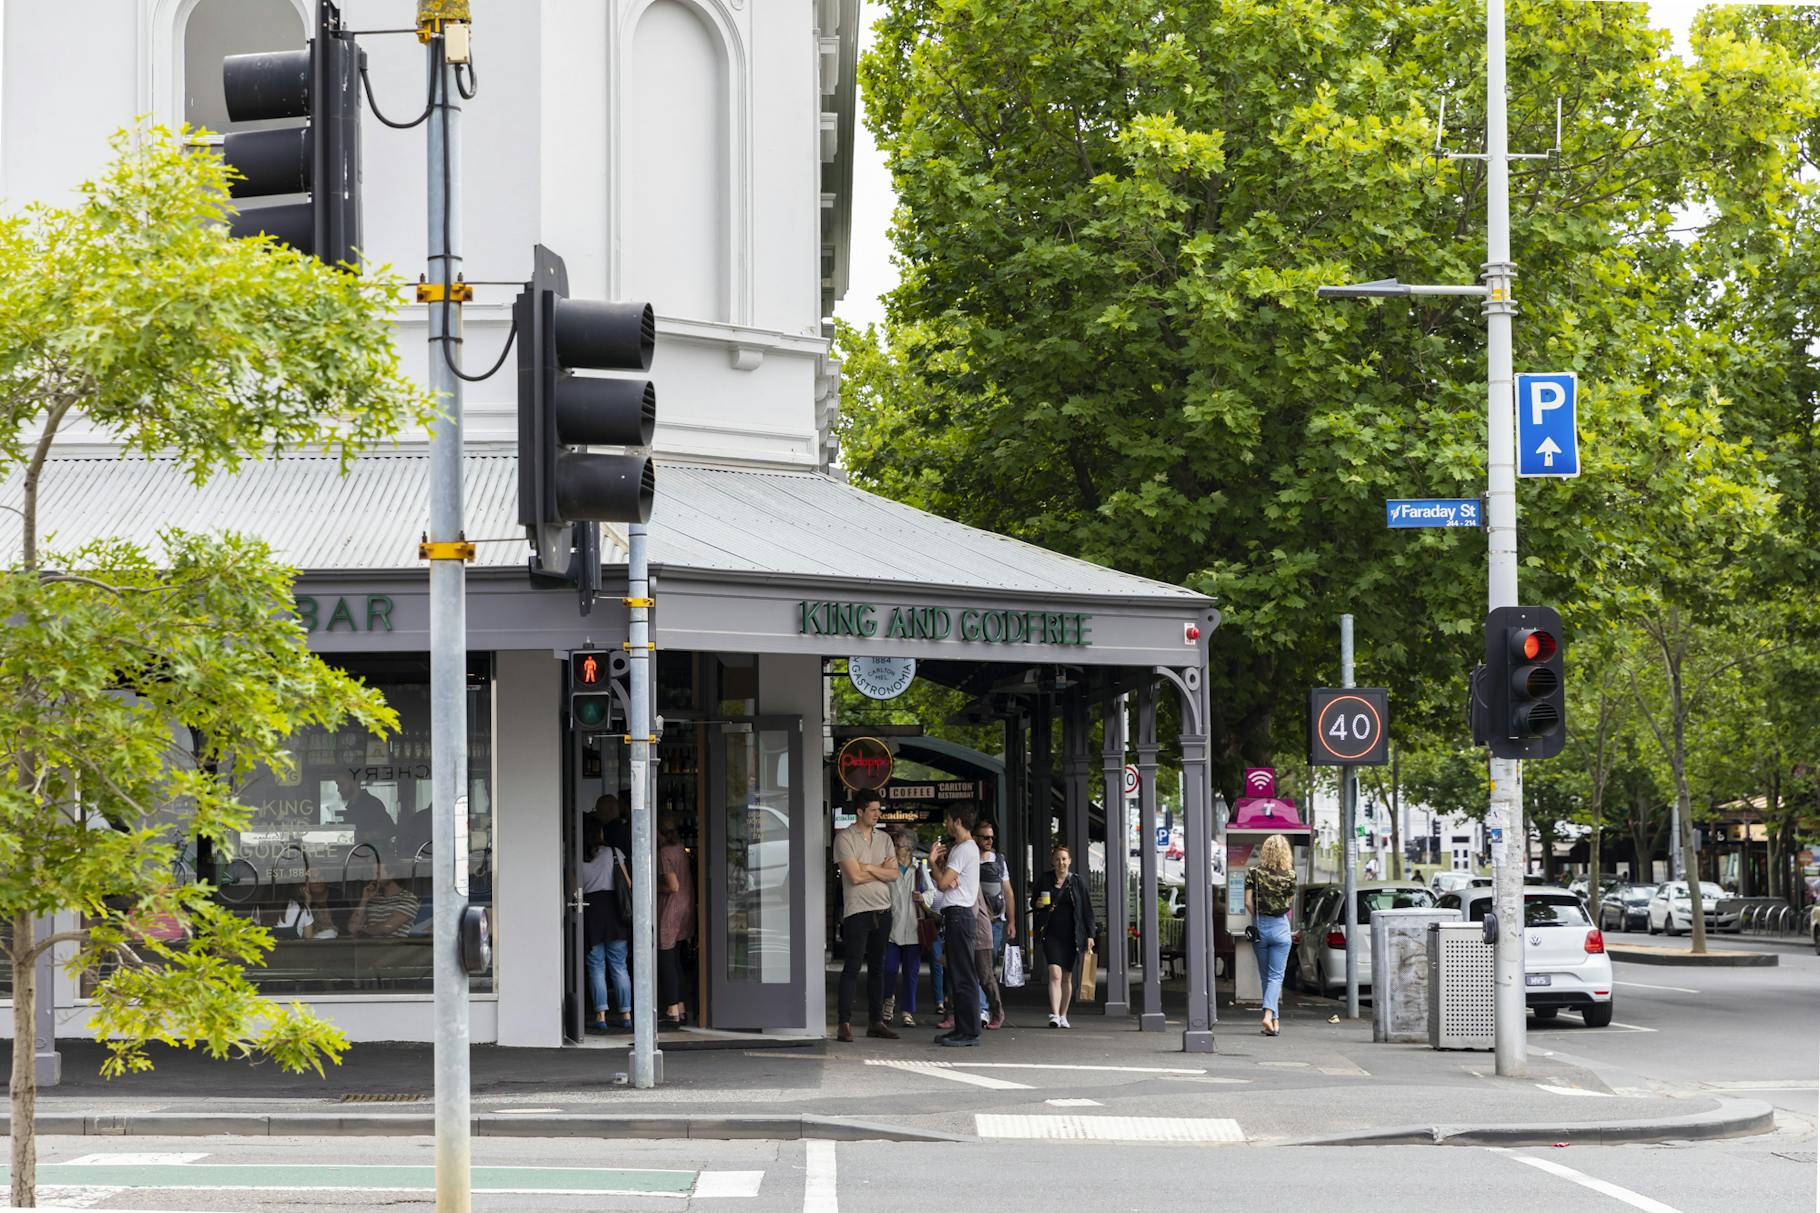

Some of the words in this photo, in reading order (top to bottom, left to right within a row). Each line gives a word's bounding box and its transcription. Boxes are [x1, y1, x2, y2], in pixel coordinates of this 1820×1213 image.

[1530, 381, 1566, 425] P
[1401, 504, 1456, 520] Faraday
[1460, 504, 1476, 517] St
[1464, 519, 1476, 527] 214
[294, 594, 394, 632] BAR
[799, 600, 878, 638] KING
[884, 606, 951, 641] AND
[961, 608, 1093, 645] GODFREE
[871, 656, 892, 665] 1884
[851, 664, 912, 696] GASTRONOMIA
[1329, 713, 1370, 740] 40
[893, 788, 932, 797] COFFEE
[262, 799, 314, 816] KING
[1159, 829, 1168, 841] P
